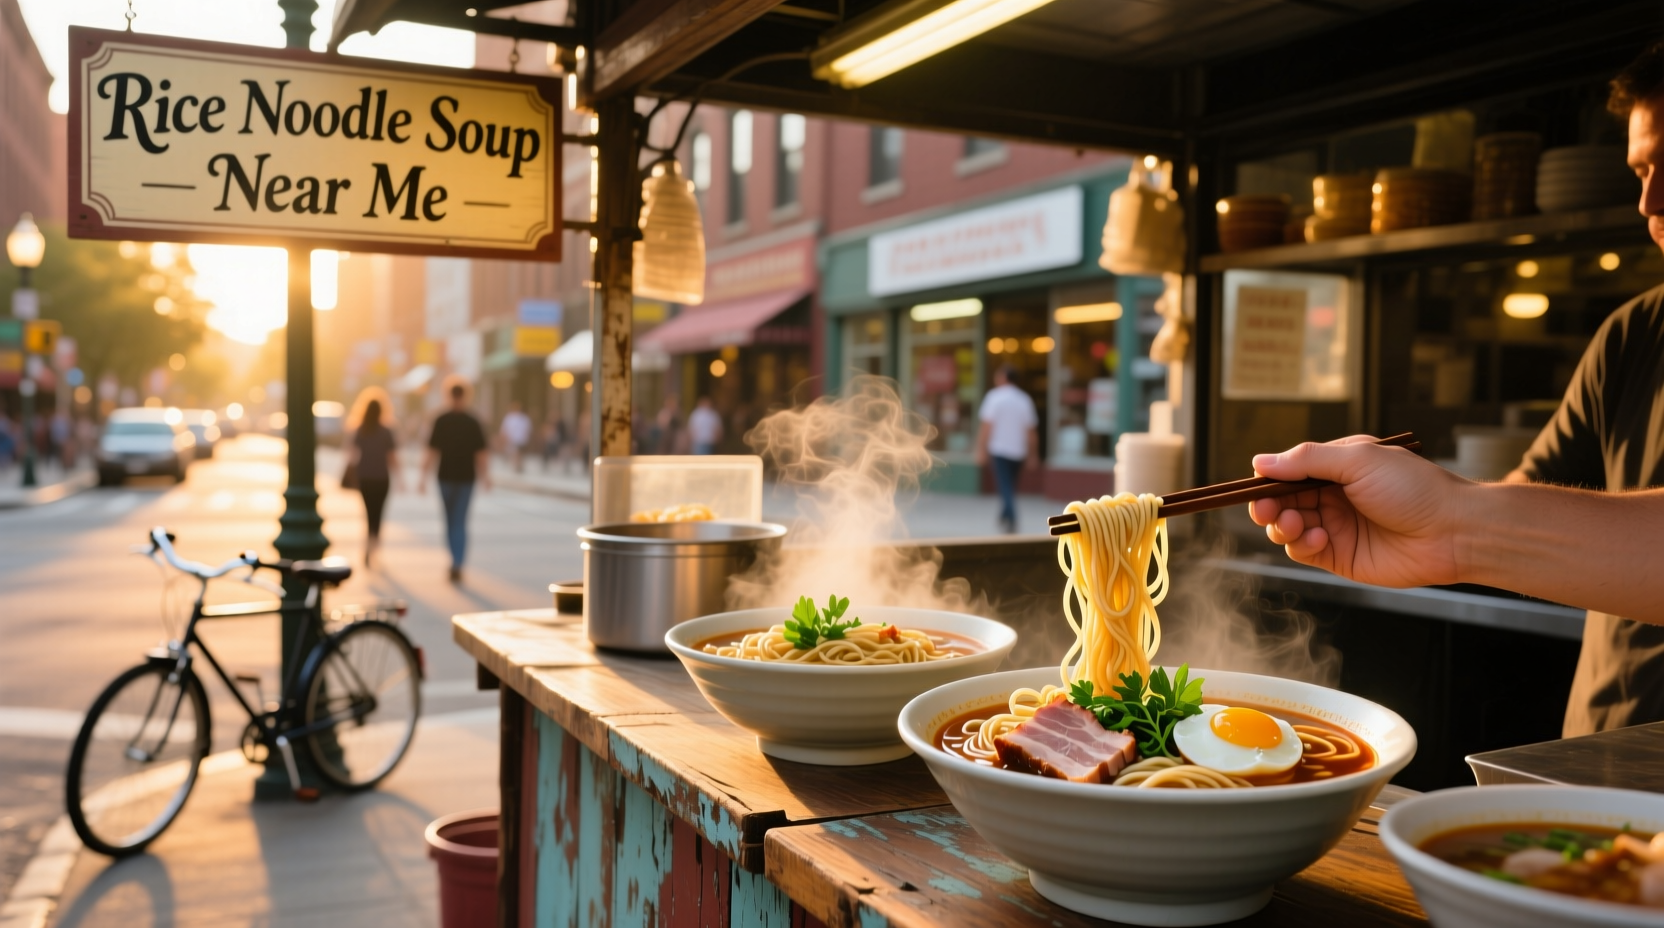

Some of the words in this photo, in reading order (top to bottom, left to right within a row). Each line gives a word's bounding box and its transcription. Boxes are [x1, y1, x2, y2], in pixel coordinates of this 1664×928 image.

[97, 72, 226, 154] Rice
[238, 80, 412, 143] Noodle
[425, 95, 541, 178] Soup
[207, 153, 351, 214] Near
[362, 162, 448, 222] Me
